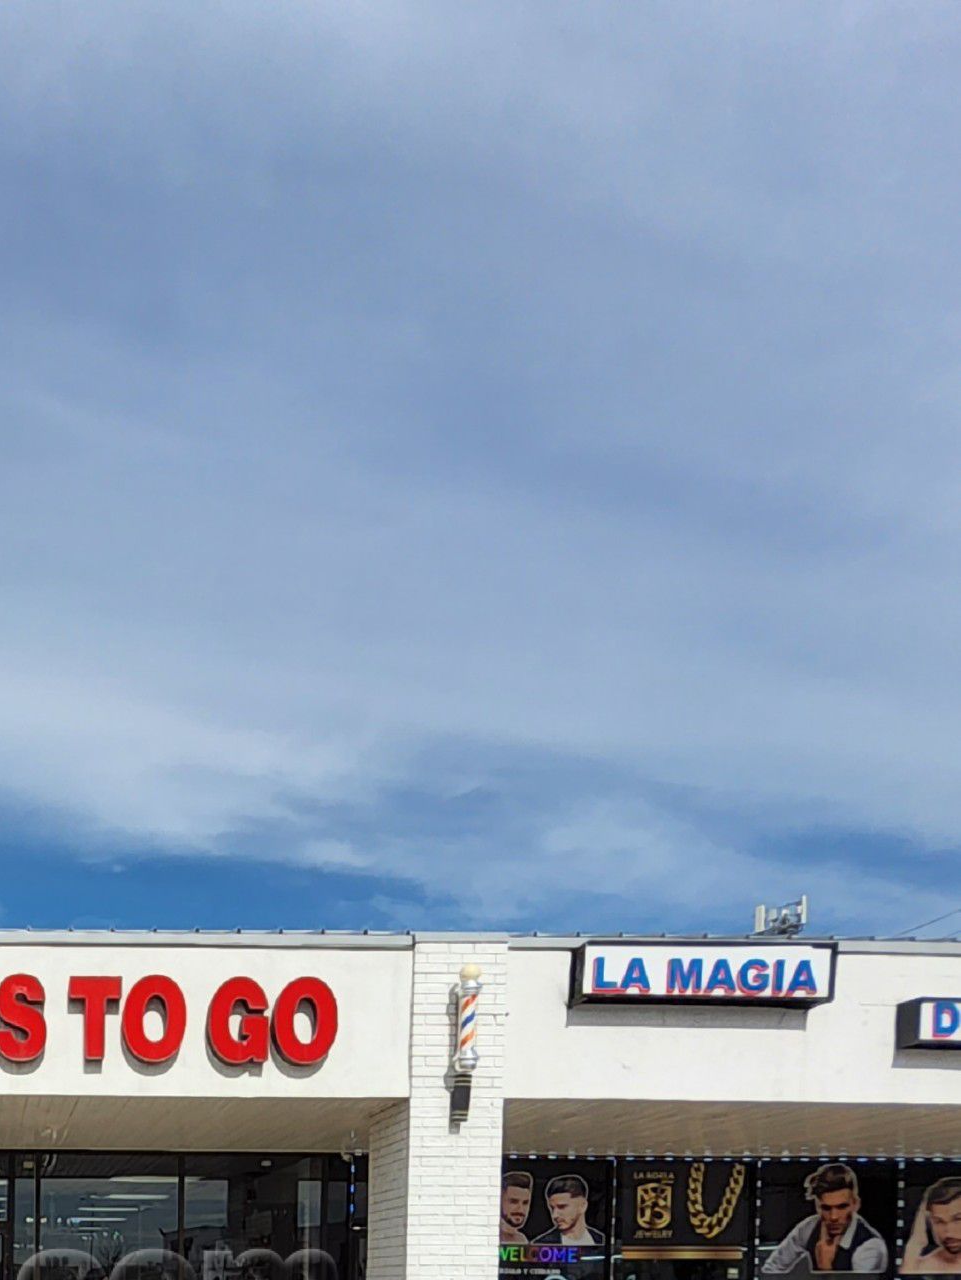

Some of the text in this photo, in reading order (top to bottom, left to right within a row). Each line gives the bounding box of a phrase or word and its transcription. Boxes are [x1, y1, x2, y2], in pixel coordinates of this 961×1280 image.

[592, 957, 818, 996] LA MAGIA
[68, 974, 187, 1062] TO
[206, 976, 338, 1066] GO
